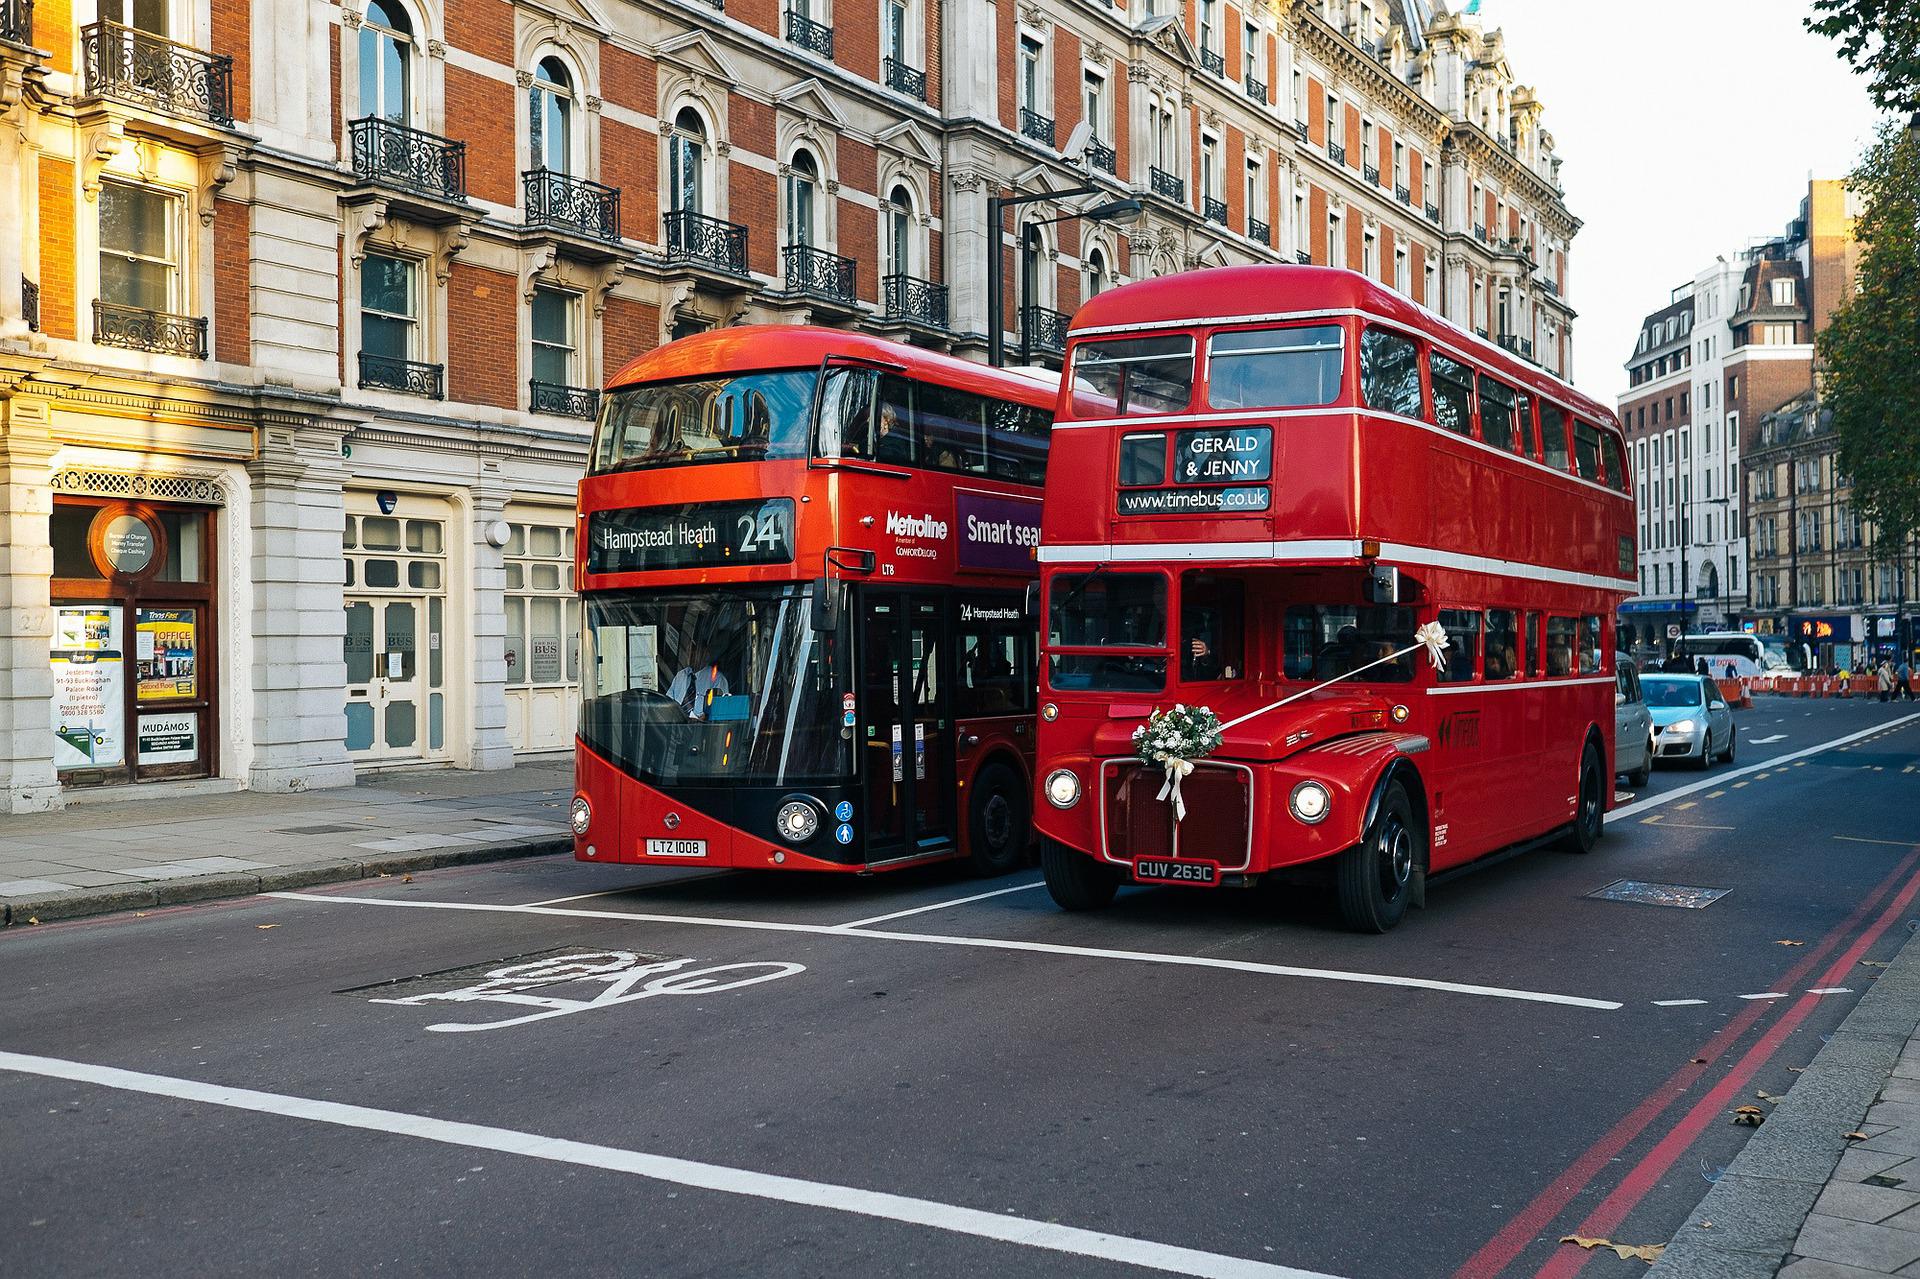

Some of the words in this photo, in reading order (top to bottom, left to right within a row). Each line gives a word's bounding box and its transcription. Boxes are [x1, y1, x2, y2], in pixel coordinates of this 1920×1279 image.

[1190, 436, 1258, 453] GERALD
[1186, 461, 1199, 476] &
[1203, 459, 1261, 476] JENNY
[1126, 488, 1266, 509] www.timebus.co.uk
[885, 509, 948, 540] Metroline
[967, 514, 1013, 545] Smart
[604, 523, 673, 554] Hampstead
[679, 521, 716, 545] Heath
[737, 514, 781, 553] 24
[882, 563, 895, 576] LT8
[960, 603, 973, 621] 24
[973, 607, 1003, 621] Hampstead
[1003, 607, 1020, 619] Heath
[159, 631, 192, 640] OFFICE
[345, 637, 371, 646] BUS
[387, 637, 413, 646] BUS
[534, 645, 557, 654] BUS
[75, 677, 112, 685] Buckingham
[142, 721, 190, 733] MUDÁMOS
[653, 841, 673, 853] LTZ
[675, 841, 699, 854] 1008
[1138, 861, 1168, 877] CUV
[1172, 864, 1212, 881] 263C
